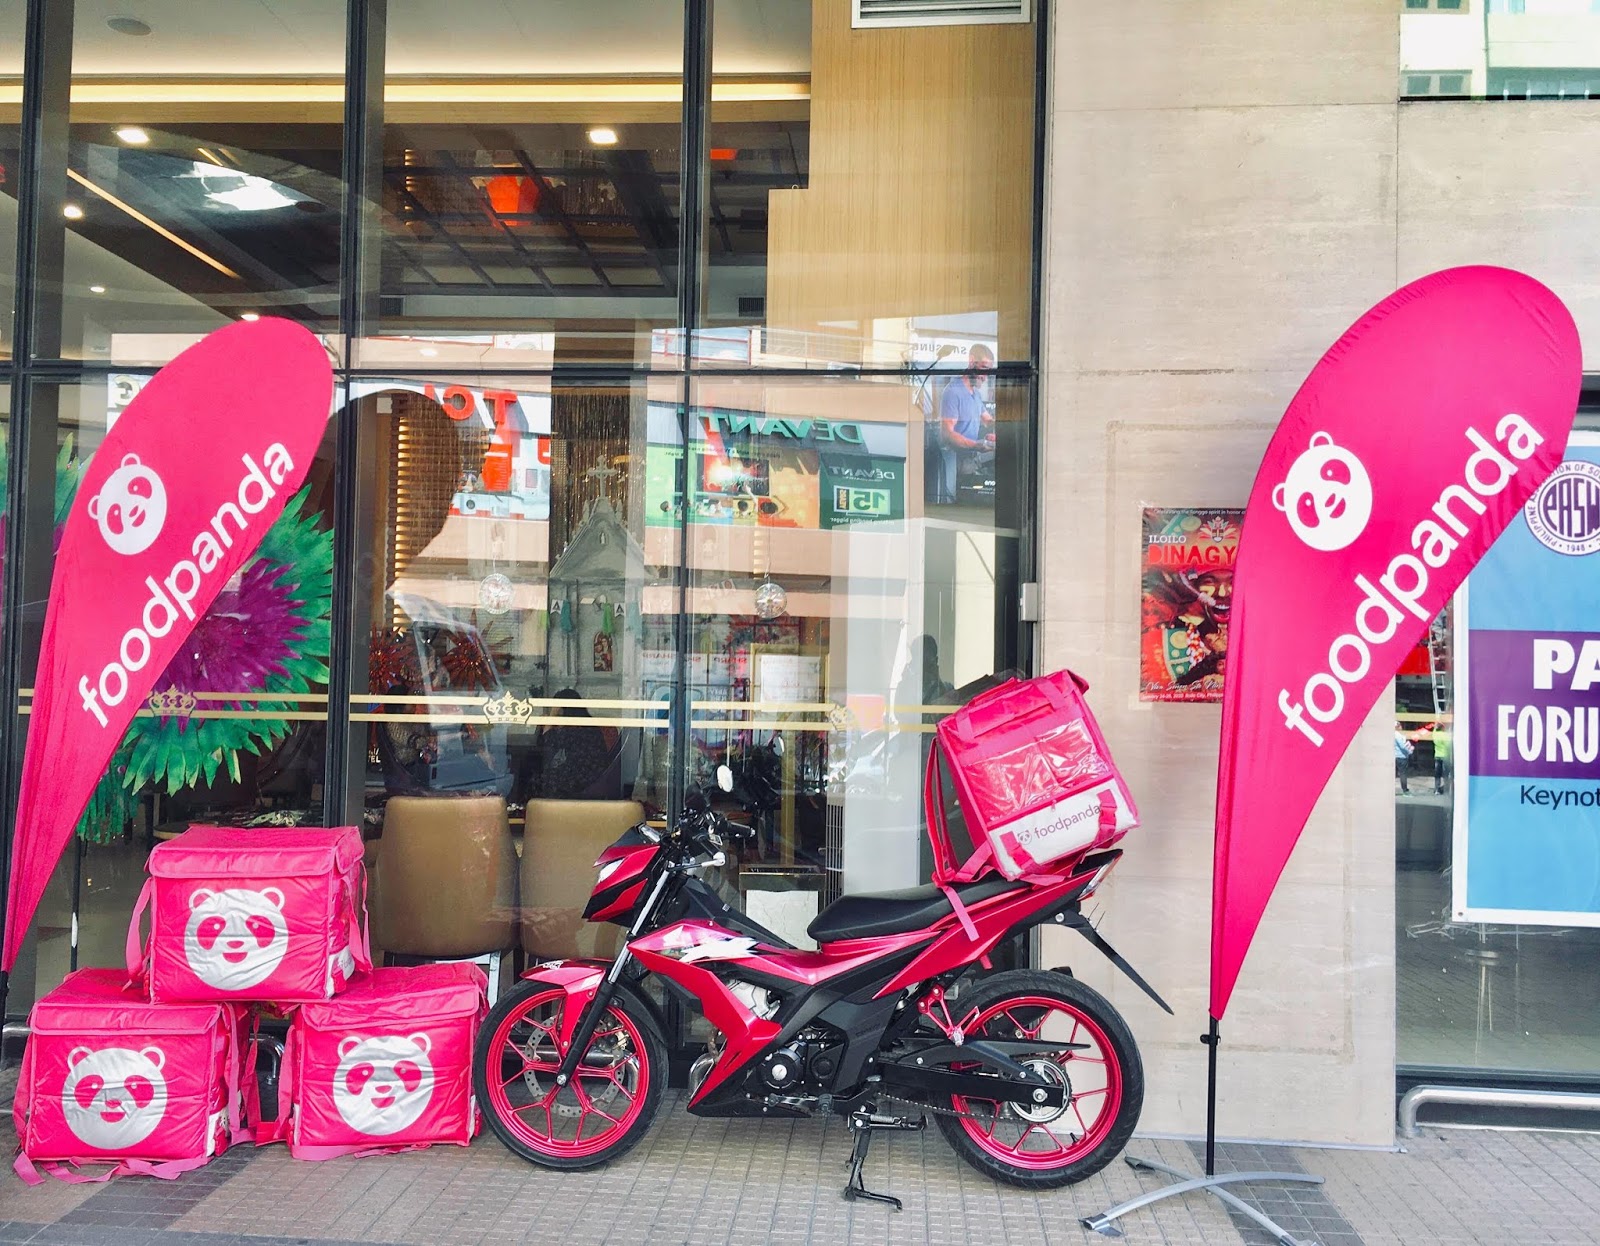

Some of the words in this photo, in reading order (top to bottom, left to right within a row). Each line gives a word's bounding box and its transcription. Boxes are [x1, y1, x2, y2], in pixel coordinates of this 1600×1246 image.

[1574, 463, 1586, 472] OF
[1149, 534, 1187, 544] ILOILO
[1527, 505, 1558, 547] PHILIPPINE
[79, 442, 294, 728] foodpanda
[1278, 412, 1545, 748] foodpanda
[1498, 704, 1599, 764] FORU
[1520, 785, 1600, 811] Keynot
[1034, 804, 1102, 839] foodpanda
